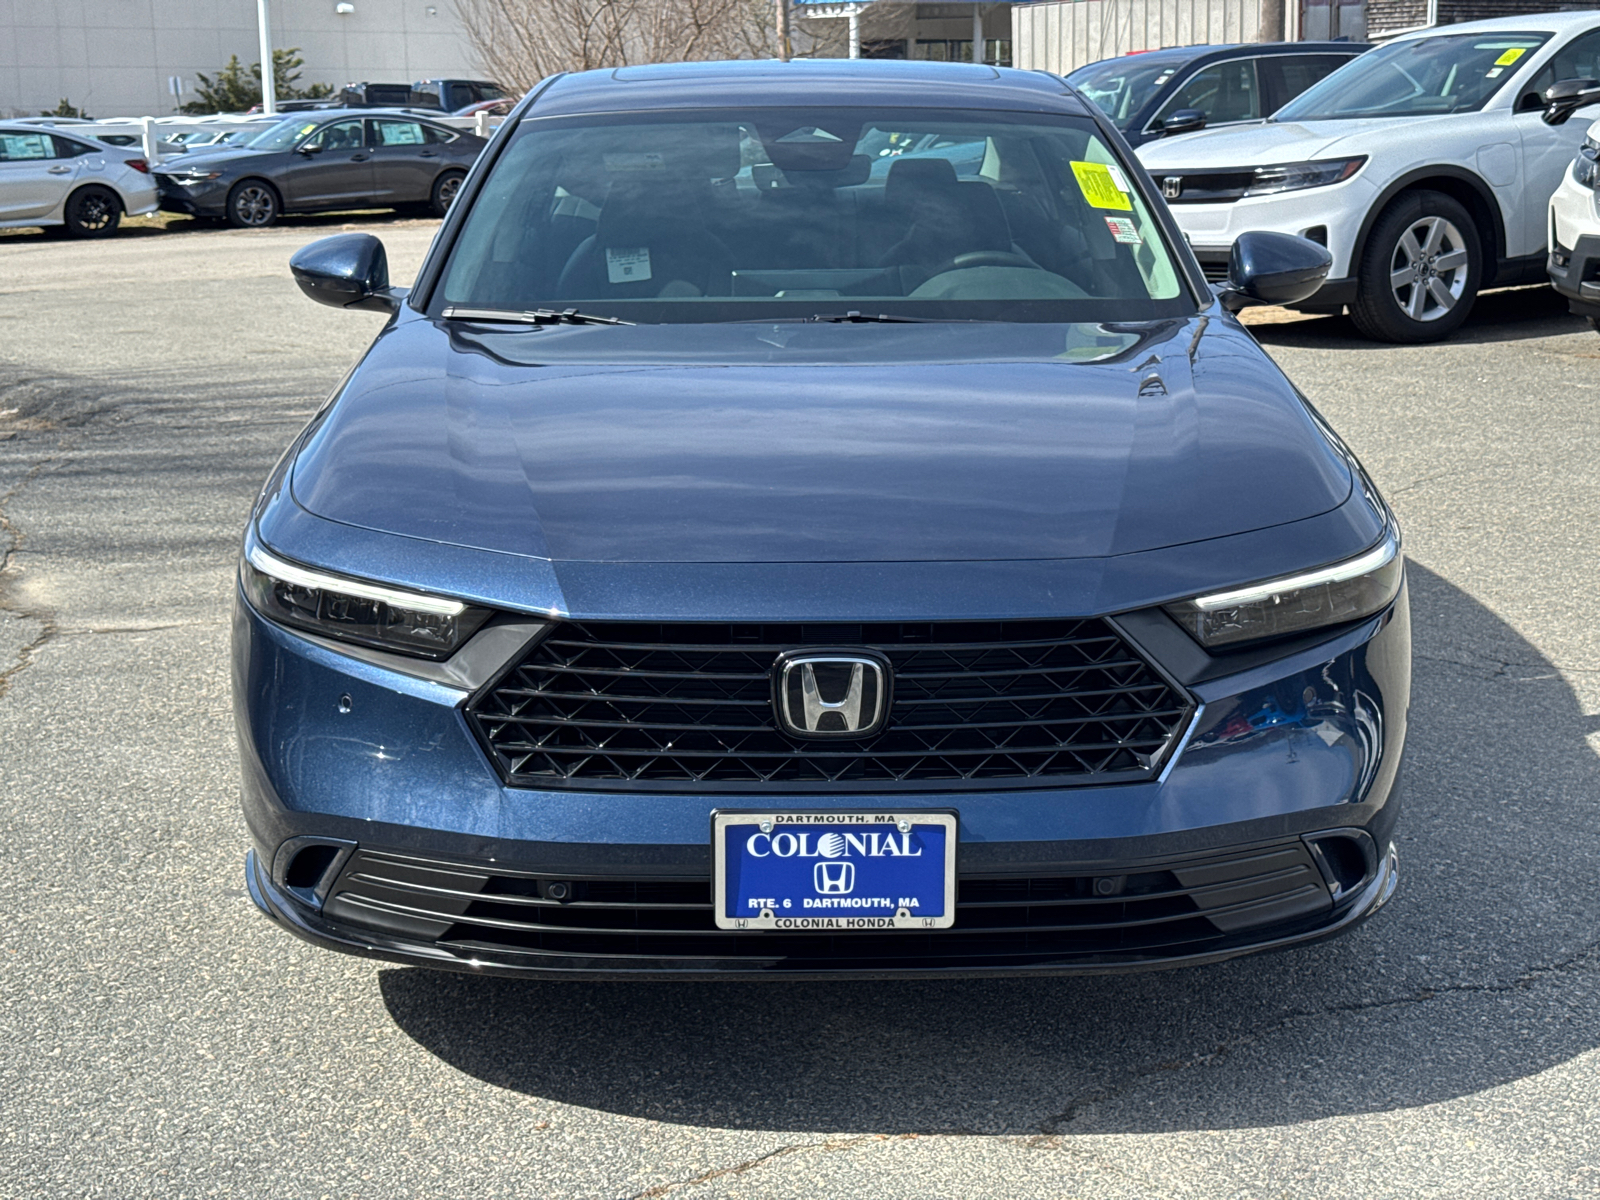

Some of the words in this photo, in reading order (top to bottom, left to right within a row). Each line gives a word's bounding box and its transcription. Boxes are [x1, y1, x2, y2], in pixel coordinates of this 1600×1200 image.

[874, 814, 896, 823] MA
[746, 832, 922, 858] COLONIAL
[748, 898, 780, 909] RTE.
[782, 898, 793, 909] 6
[803, 898, 895, 910] DARTMOUTH,
[898, 898, 920, 909] MA
[775, 918, 843, 929] COLONIAL
[847, 918, 896, 929] HONDA
